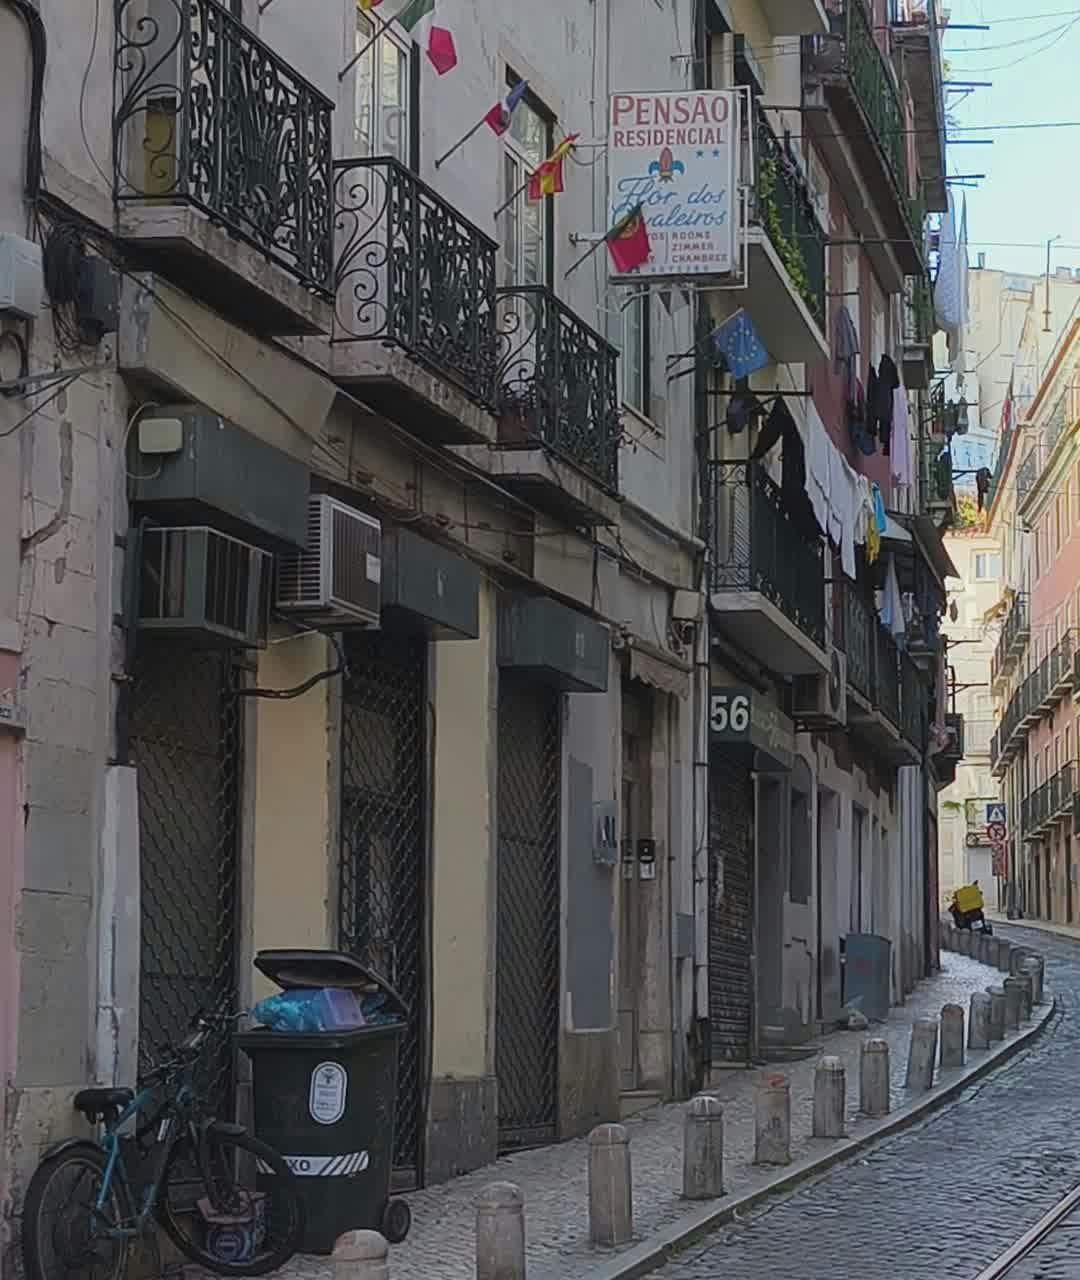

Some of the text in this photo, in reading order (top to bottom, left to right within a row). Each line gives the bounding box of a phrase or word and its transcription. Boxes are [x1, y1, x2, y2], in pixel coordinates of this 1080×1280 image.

[613, 128, 725, 147] RESIDENCIAL
[618, 176, 726, 206] Flor dos
[611, 201, 727, 228] Caleiros
[710, 695, 749, 732] 56
